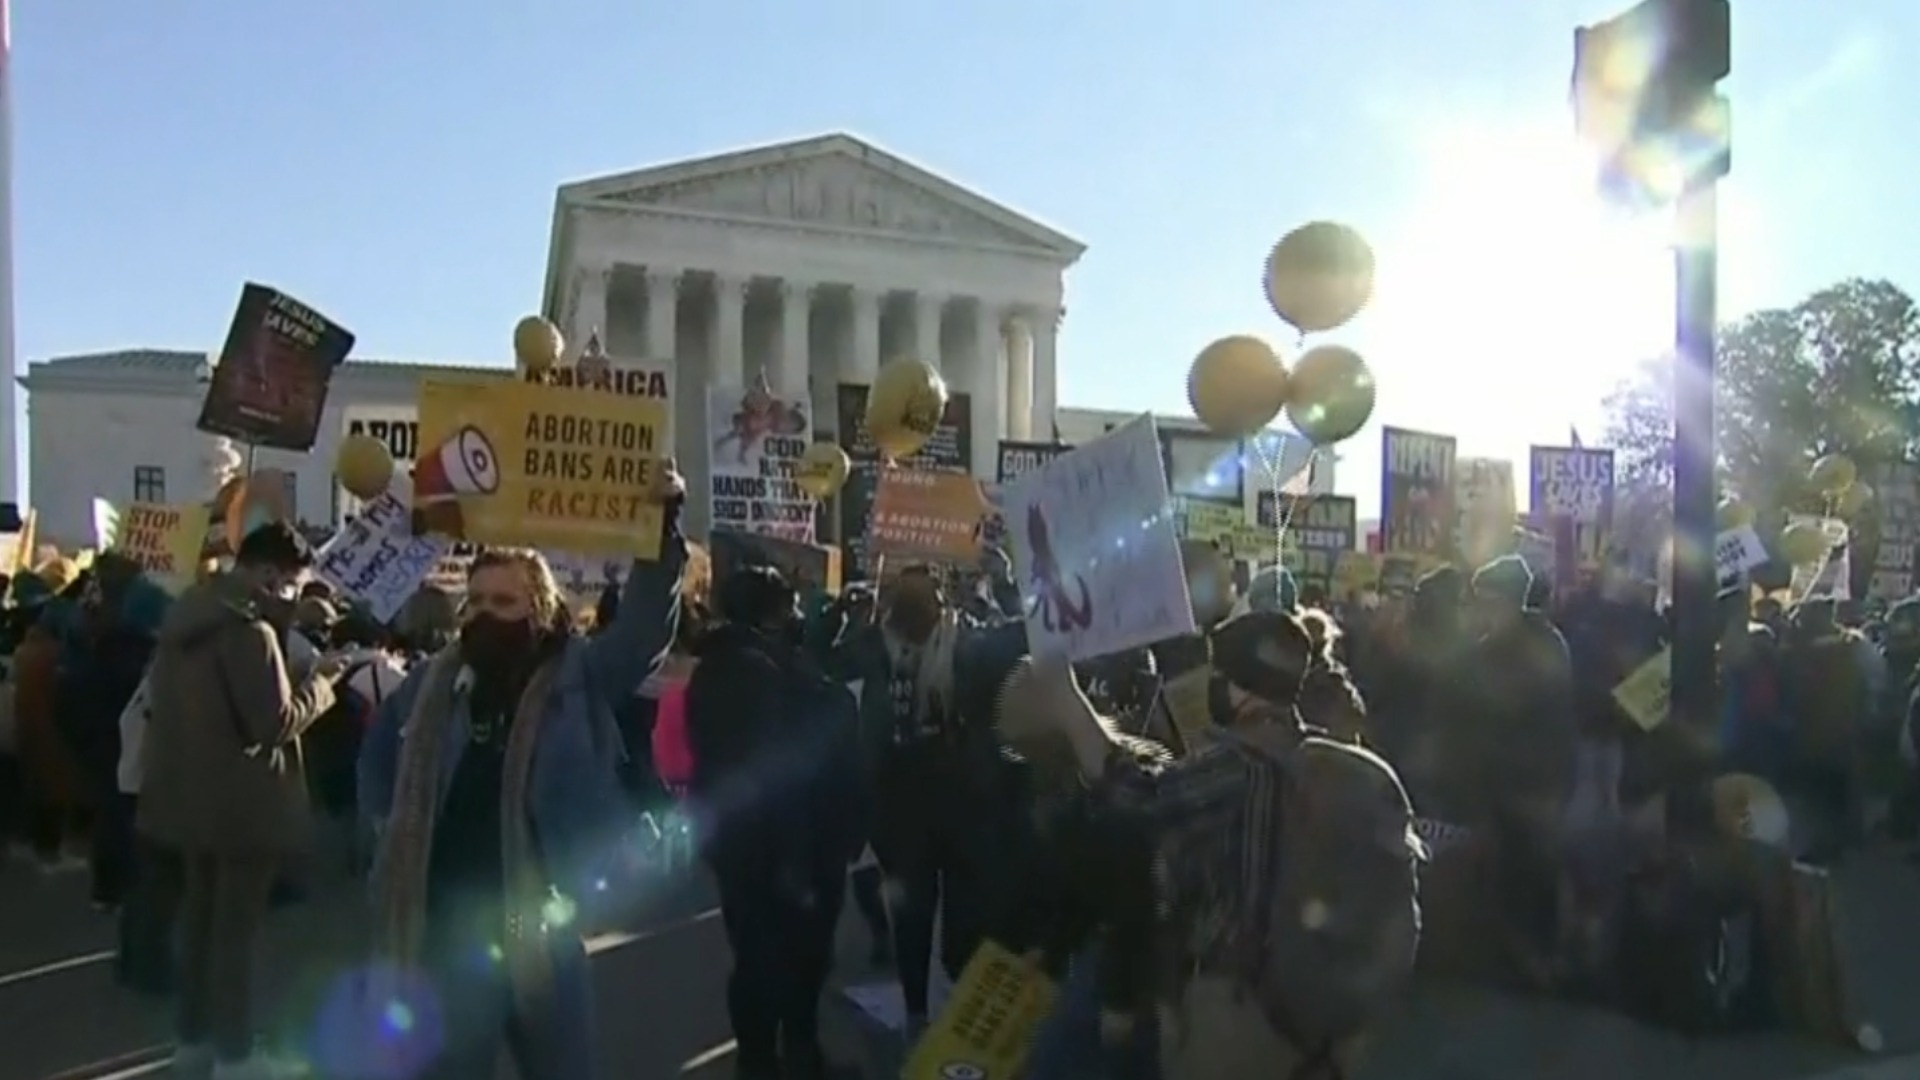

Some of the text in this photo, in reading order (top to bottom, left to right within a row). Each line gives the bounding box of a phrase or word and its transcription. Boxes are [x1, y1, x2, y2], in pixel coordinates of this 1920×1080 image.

[525, 412, 654, 450] ABORTION
[524, 449, 650, 486] BANS ARE
[1535, 452, 1611, 486] JESUS
[712, 475, 767, 497] HANDS
[888, 512, 971, 534] ABORTION
